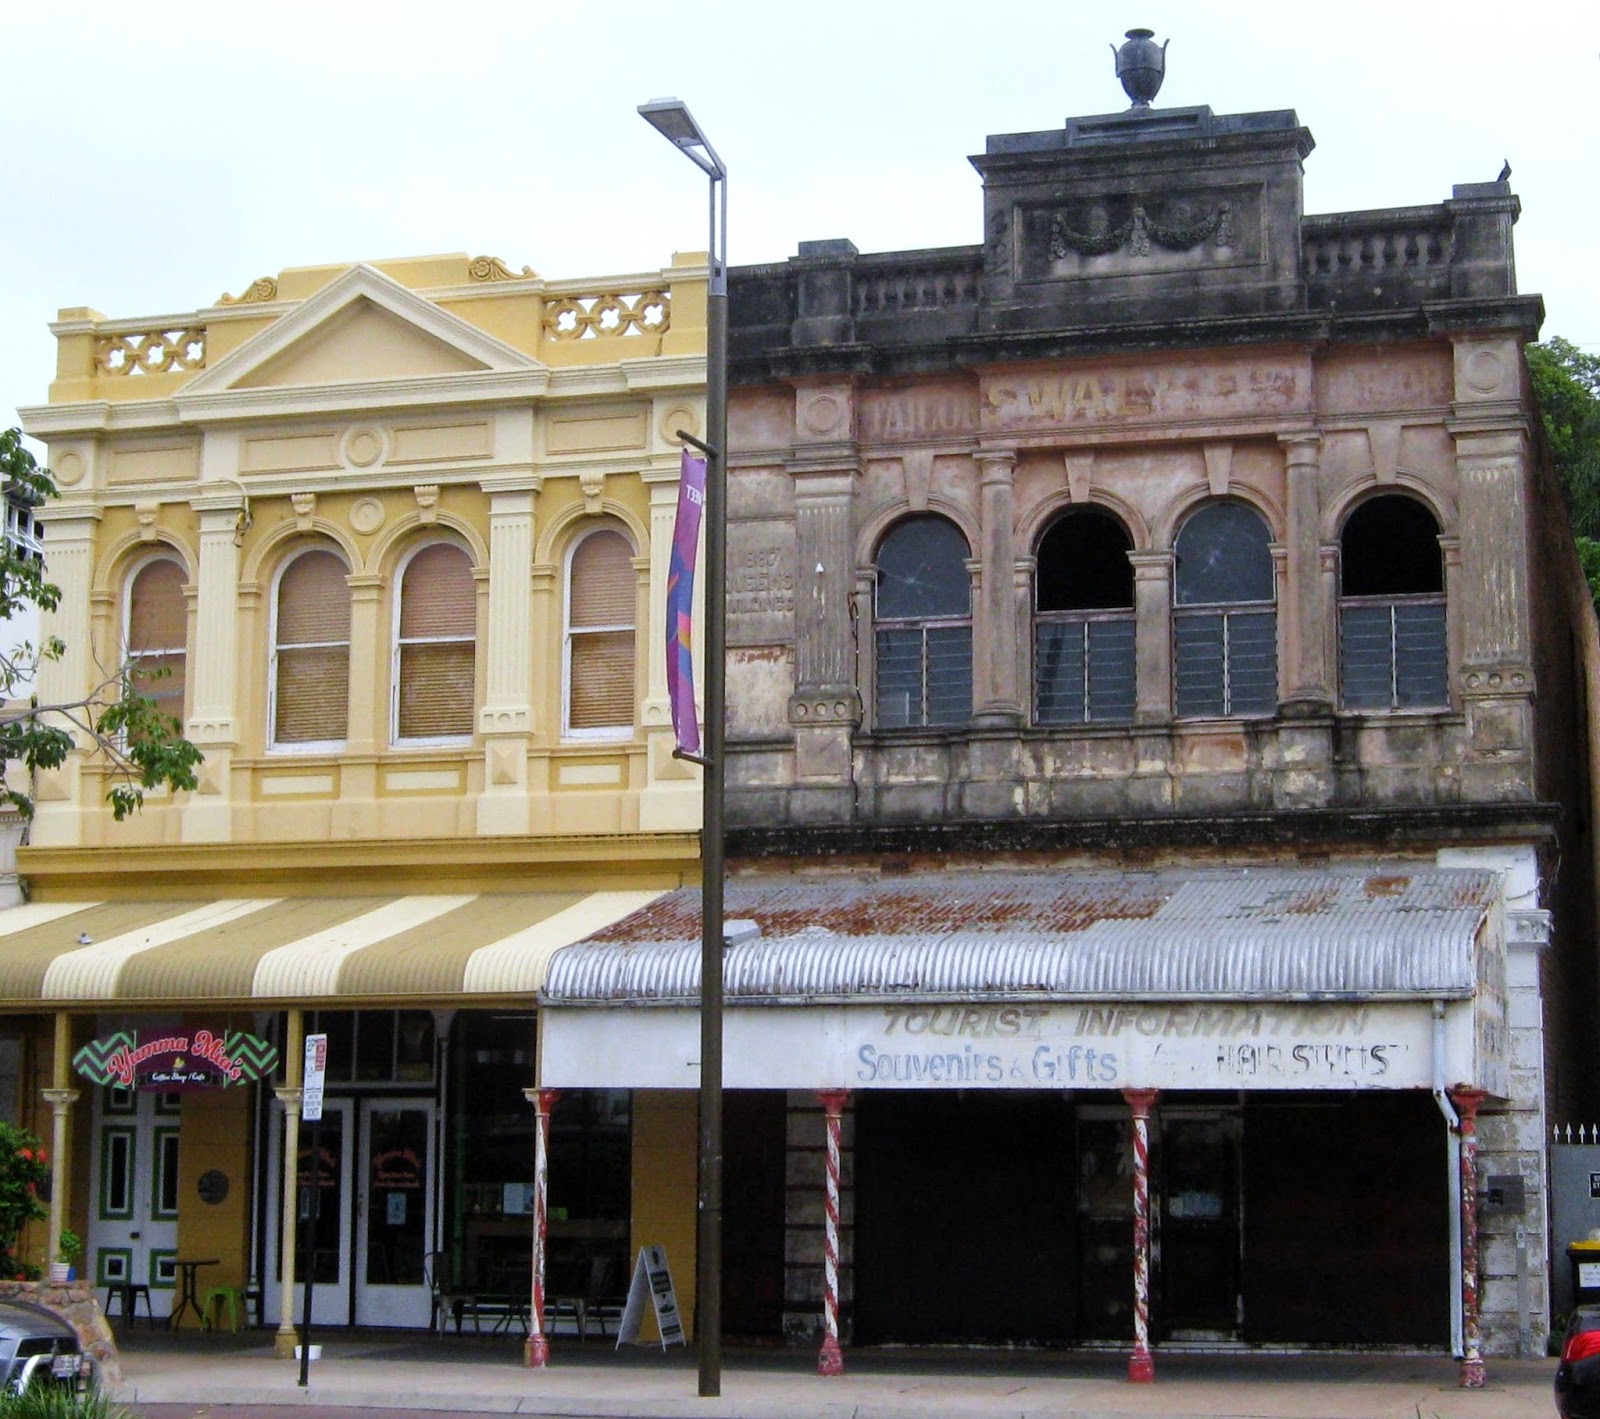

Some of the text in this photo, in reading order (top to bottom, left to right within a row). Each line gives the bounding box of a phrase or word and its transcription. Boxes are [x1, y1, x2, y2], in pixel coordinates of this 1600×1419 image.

[884, 1006, 1371, 1037] TOURIST INFORMATION
[107, 1030, 244, 1086] Yumma Mia's
[857, 1044, 1003, 1082] Souvenirs
[1032, 1044, 1118, 1082] Gifts
